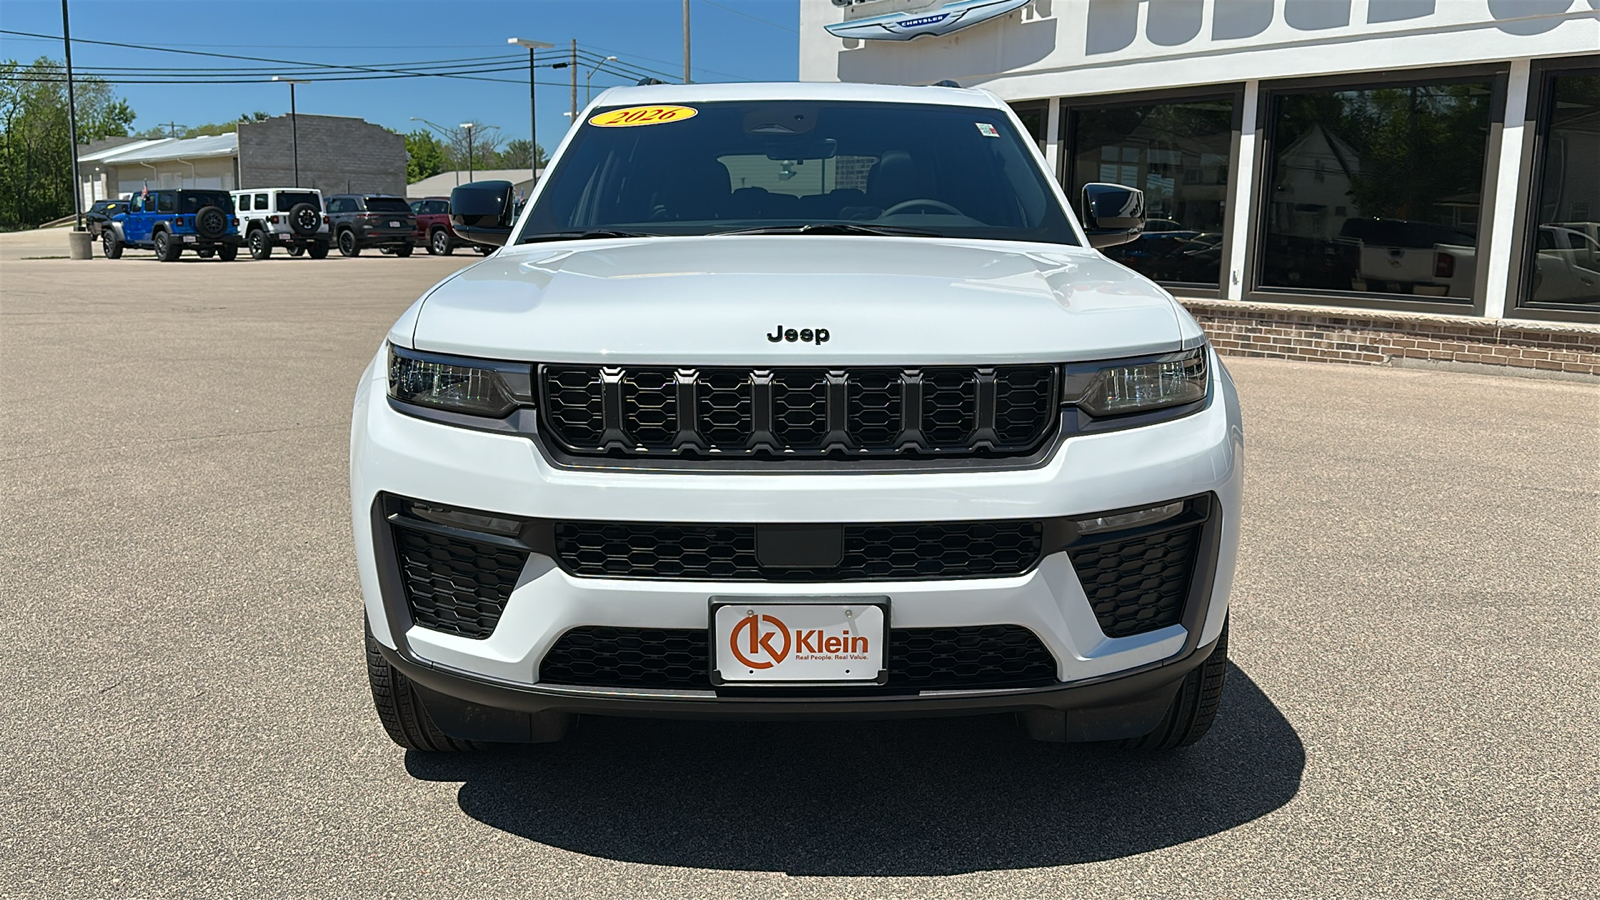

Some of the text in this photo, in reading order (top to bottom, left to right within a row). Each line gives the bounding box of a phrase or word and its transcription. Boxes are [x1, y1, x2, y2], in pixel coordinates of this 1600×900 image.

[901, 16, 943, 27] CHRYSLER
[605, 107, 685, 125] 2026
[766, 324, 830, 346] Jeep
[795, 630, 869, 653] Klein
